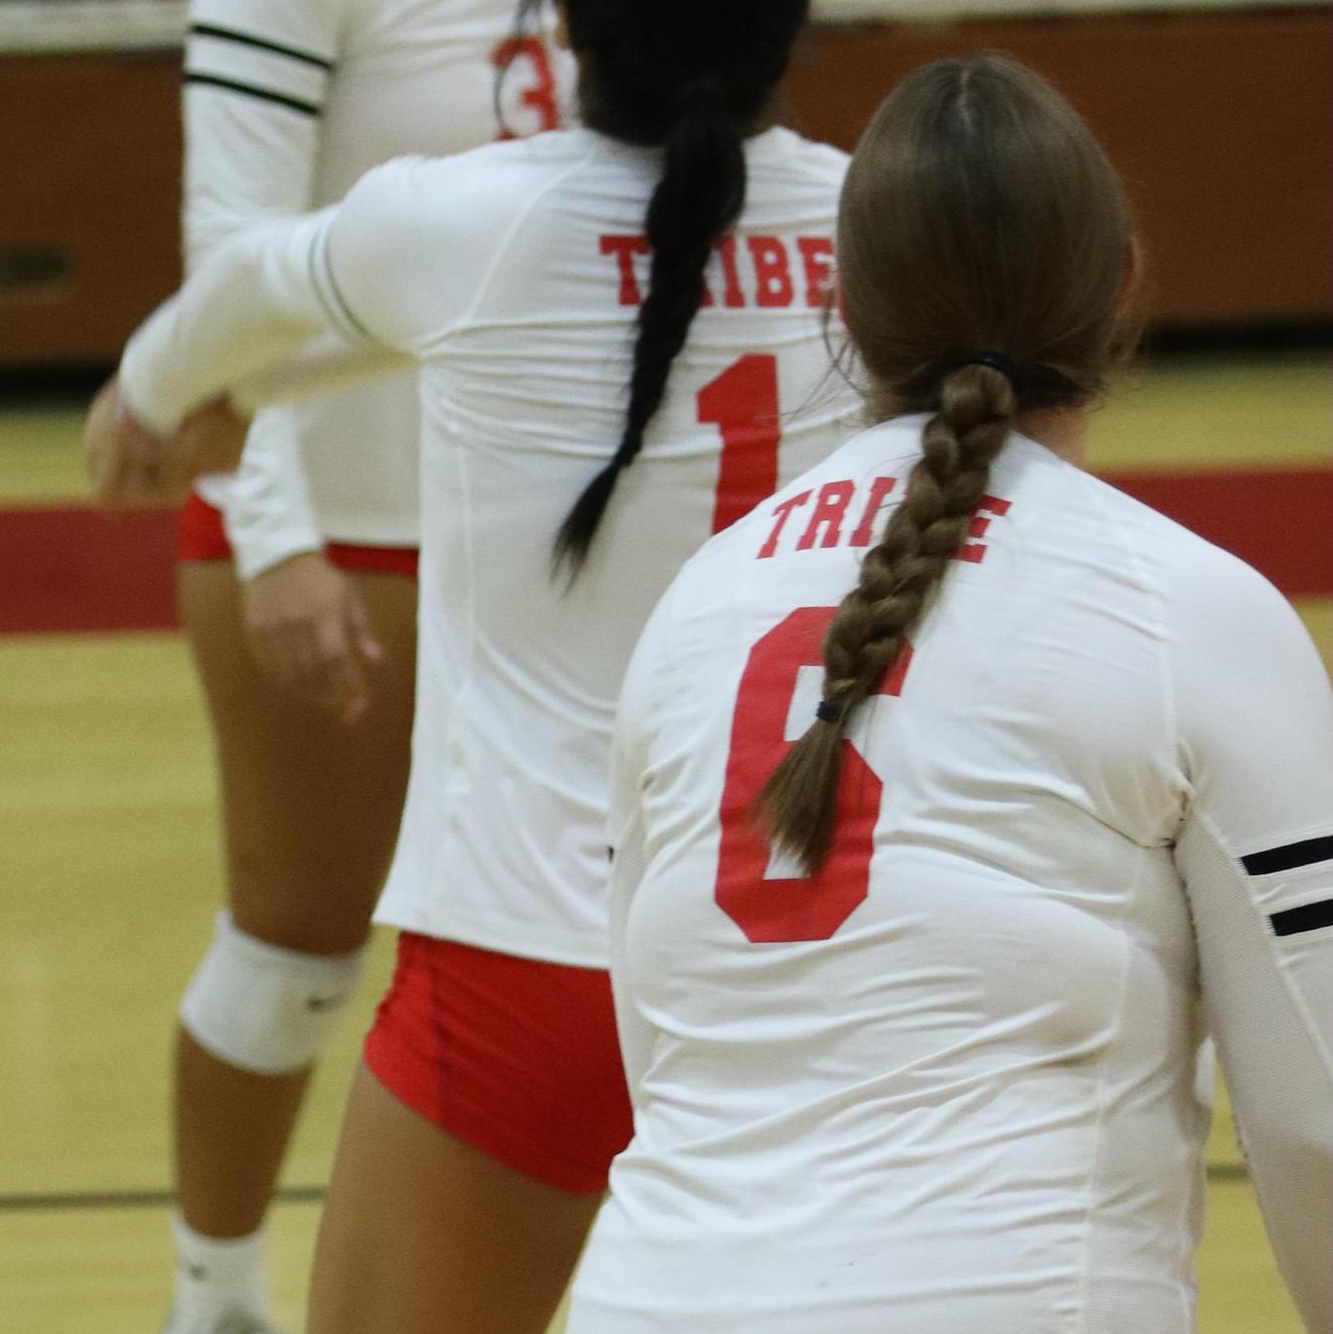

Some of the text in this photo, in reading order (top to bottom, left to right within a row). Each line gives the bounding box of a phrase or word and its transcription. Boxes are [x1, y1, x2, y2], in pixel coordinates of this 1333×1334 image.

[491, 35, 561, 143] 3
[599, 234, 836, 308] TIBE
[696, 353, 780, 535] 1
[756, 476, 1012, 564] TRIE
[715, 606, 915, 943] 6
